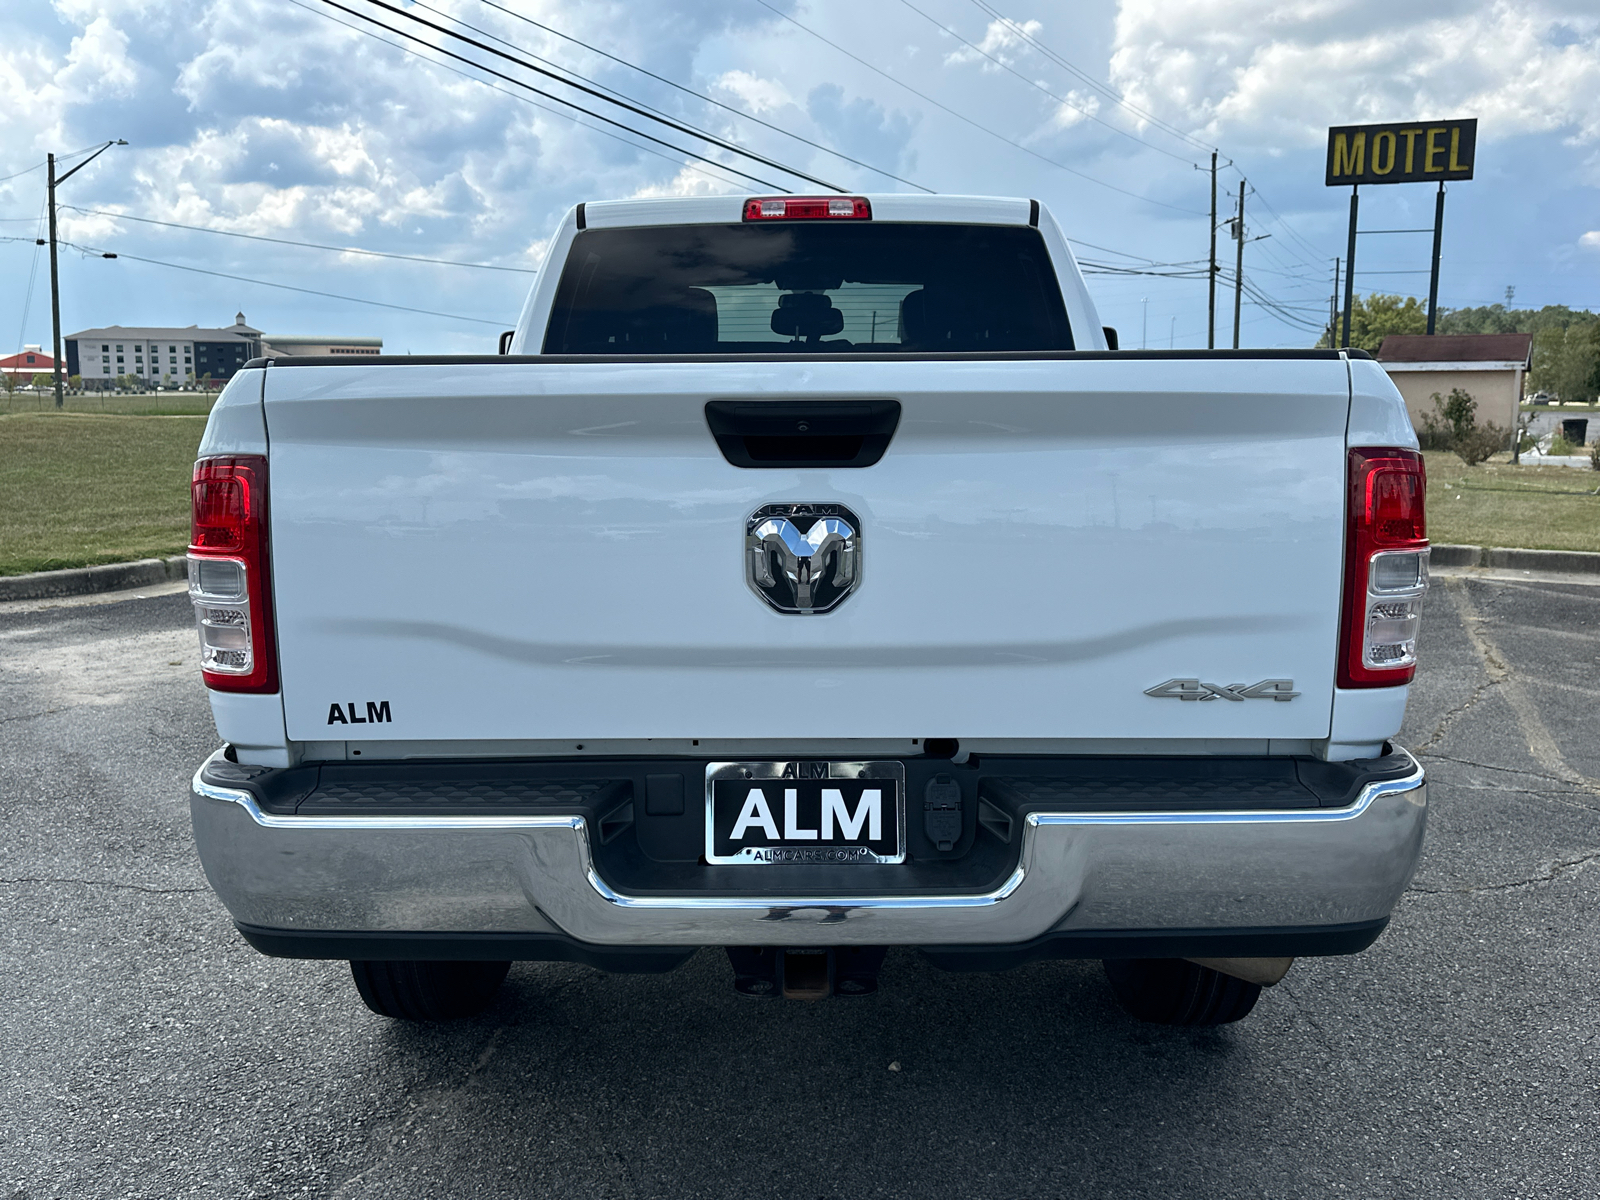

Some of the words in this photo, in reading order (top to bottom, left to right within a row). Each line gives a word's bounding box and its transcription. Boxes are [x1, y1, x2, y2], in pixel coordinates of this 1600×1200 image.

[1333, 127, 1469, 177] MOTEL
[769, 505, 838, 515] RAM
[1143, 678, 1302, 702] 4x4
[327, 700, 392, 725] ALM
[782, 762, 829, 779] ALM
[729, 788, 882, 841] ALM
[753, 849, 860, 862] ALMCARS.COM
